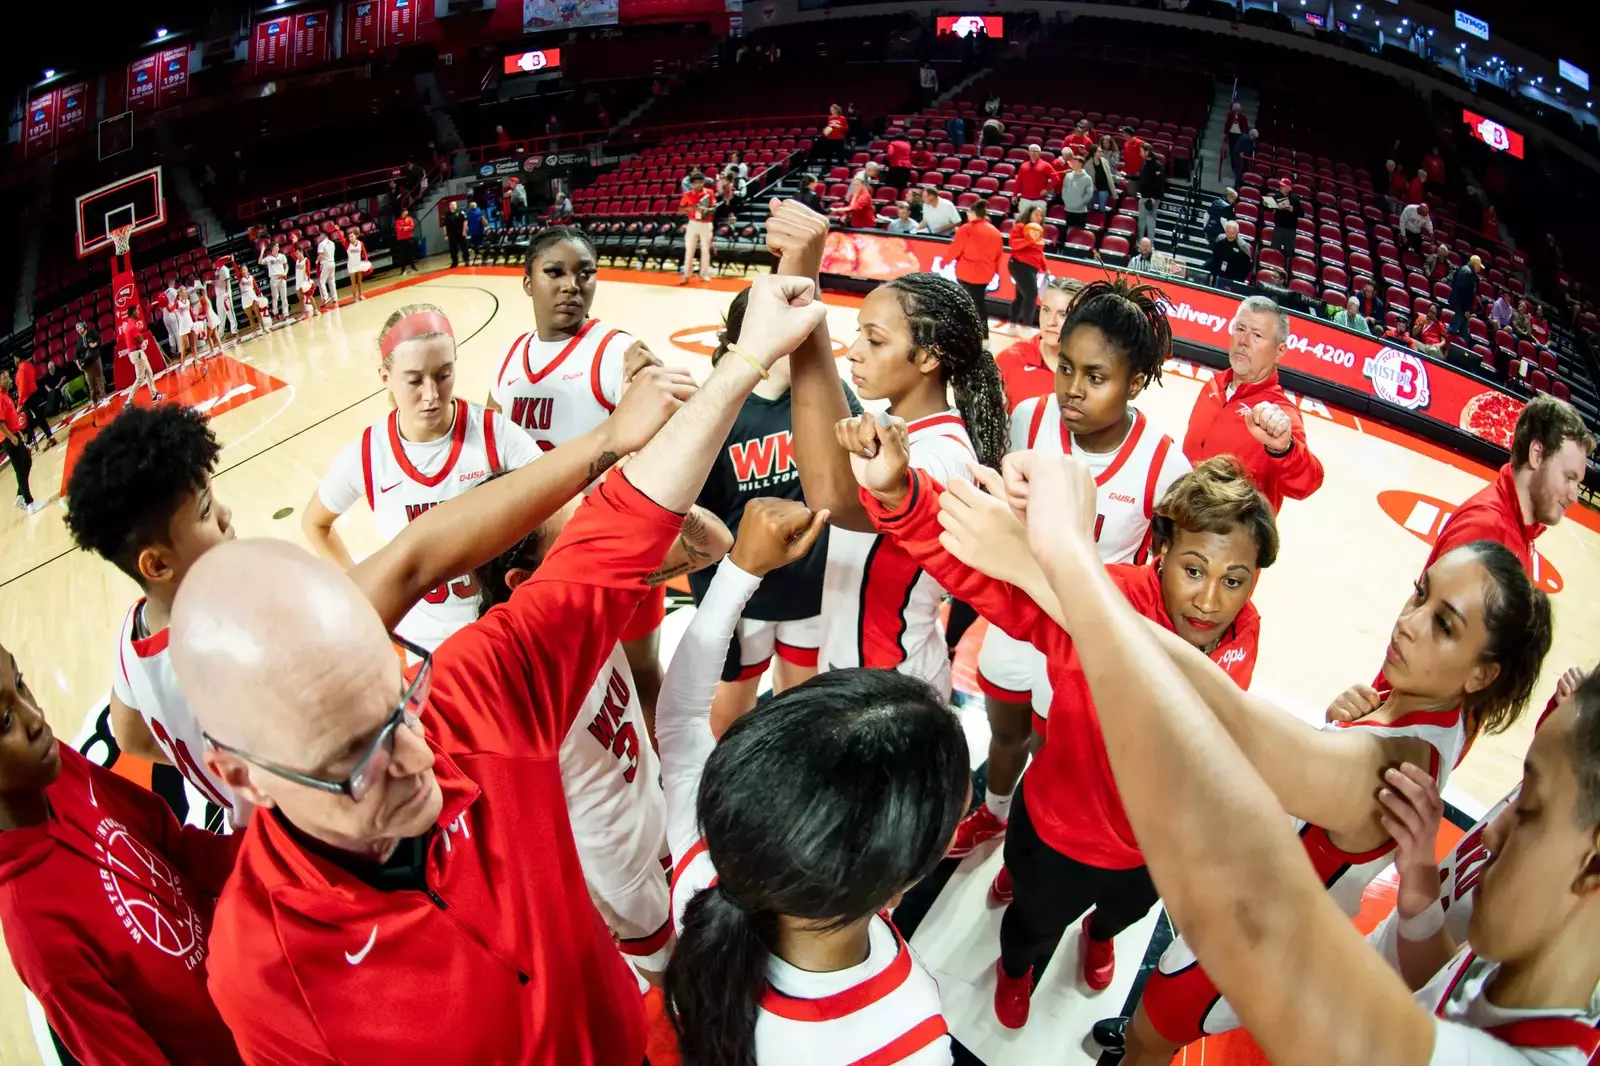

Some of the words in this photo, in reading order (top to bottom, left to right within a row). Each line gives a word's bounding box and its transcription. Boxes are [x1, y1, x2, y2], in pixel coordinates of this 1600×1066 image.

[1457, 13, 1487, 33] ATMOS
[131, 82, 153, 96] 1986
[163, 72, 185, 85] 1992
[61, 108, 82, 122] 1985
[29, 121, 49, 136] 1971
[496, 161, 519, 170] Comfort
[1287, 333, 1356, 368] 04-4200
[1365, 361, 1410, 387] MISTER
[511, 396, 555, 430] WKU
[728, 430, 797, 483] WK
[738, 470, 800, 492] HILLTOP
[1217, 646, 1247, 671] ops
[586, 665, 631, 751] WKU
